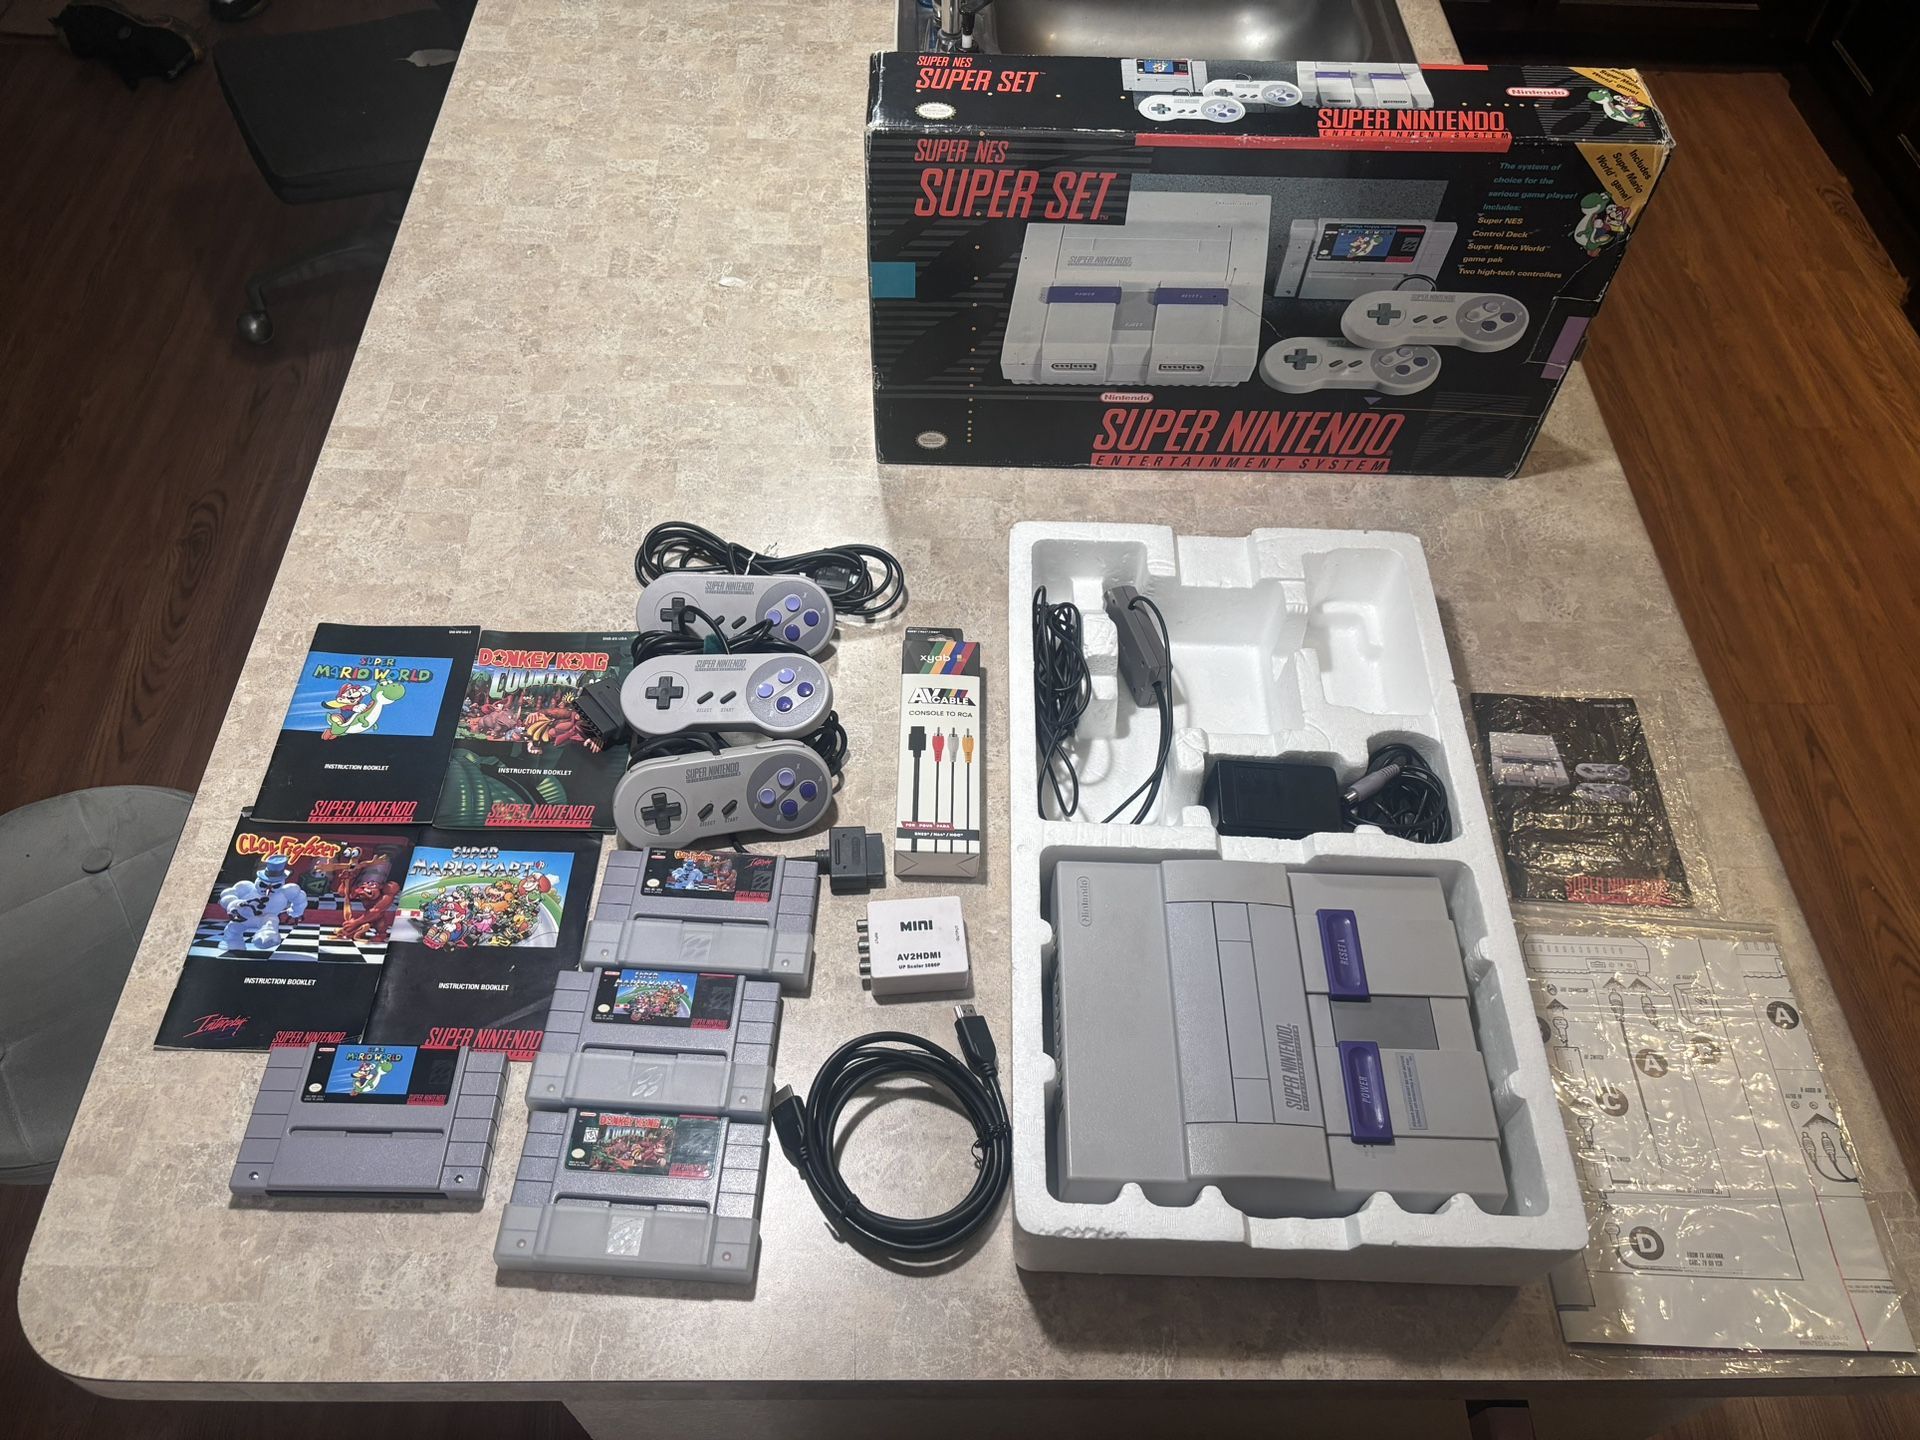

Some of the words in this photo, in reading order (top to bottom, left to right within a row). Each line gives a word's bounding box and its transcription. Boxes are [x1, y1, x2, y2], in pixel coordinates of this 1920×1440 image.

[916, 55, 949, 68] SUPER
[952, 56, 973, 68] NES
[915, 67, 991, 92] SUPER
[996, 70, 1040, 93] SET
[1511, 88, 1566, 96] Nintendo
[1317, 108, 1390, 130] SUPER
[1396, 110, 1506, 131] NINTENDO
[1322, 130, 1444, 138] ENTERTAINMENT
[1453, 131, 1510, 139] SYSTEM
[914, 138, 969, 163] SUPER
[976, 139, 1009, 164] NES
[1612, 152, 1631, 173] Super
[1627, 172, 1644, 194] Mario
[1629, 149, 1651, 180] Includes
[1596, 154, 1614, 177] World
[1611, 179, 1632, 202] game!
[913, 168, 1041, 219] SUPER
[1044, 170, 1117, 221] SET
[1521, 192, 1544, 200] game
[1546, 192, 1578, 200] player!
[1477, 216, 1503, 225] Super
[1472, 230, 1504, 238] Control
[1467, 242, 1492, 251] Super
[1494, 243, 1518, 251] Mario
[1458, 267, 1475, 275] Two
[1477, 268, 1516, 277] high-tech
[1517, 270, 1562, 279] controllers
[1103, 393, 1151, 402] Nintendo
[1092, 408, 1221, 451] SUPER
[1217, 410, 1406, 457] NINTENDO
[1095, 455, 1286, 469] ENTERTAINMENT
[1299, 458, 1385, 472] SYSTEM
[359, 656, 397, 667] SUPER
[478, 647, 555, 669] DONKEY
[556, 652, 609, 672] KONG
[920, 654, 951, 664] xyab
[312, 664, 372, 680] MARIO
[373, 667, 434, 684] WORLD
[488, 667, 585, 699] COUNTRY
[932, 696, 969, 706] CABLE
[324, 763, 362, 771] INSTRUCTION
[362, 764, 390, 772] BOOKLET
[498, 767, 541, 775] INSTRUCTION
[685, 766, 707, 780] SUPER
[708, 762, 740, 777] NINTENDO
[309, 800, 356, 817] SUPER
[353, 800, 419, 817] NINTENDO
[487, 803, 532, 818] SUPER
[530, 804, 596, 820] NINTENDO
[451, 846, 499, 860] SUPER
[408, 858, 478, 877] MARIO
[478, 861, 534, 879] KART
[1565, 875, 1604, 895] SUPER
[899, 919, 934, 932] MINI
[897, 951, 942, 962] AV2HDMI
[1337, 943, 1349, 966] RESET
[244, 977, 286, 985] INSTRUCTION
[286, 978, 317, 986] BOOKLET
[438, 982, 480, 990] INSTRUCTION
[480, 983, 510, 991] BOOKLET
[272, 1030, 305, 1043] SUPER
[303, 1031, 347, 1044] NINTENDO
[425, 1027, 475, 1047] SUPER
[472, 1028, 545, 1050] NINTENDO
[1275, 1024, 1300, 1075] NINTENDO
[1282, 1074, 1303, 1111] SUPER
[1358, 1075, 1371, 1104] POWER
